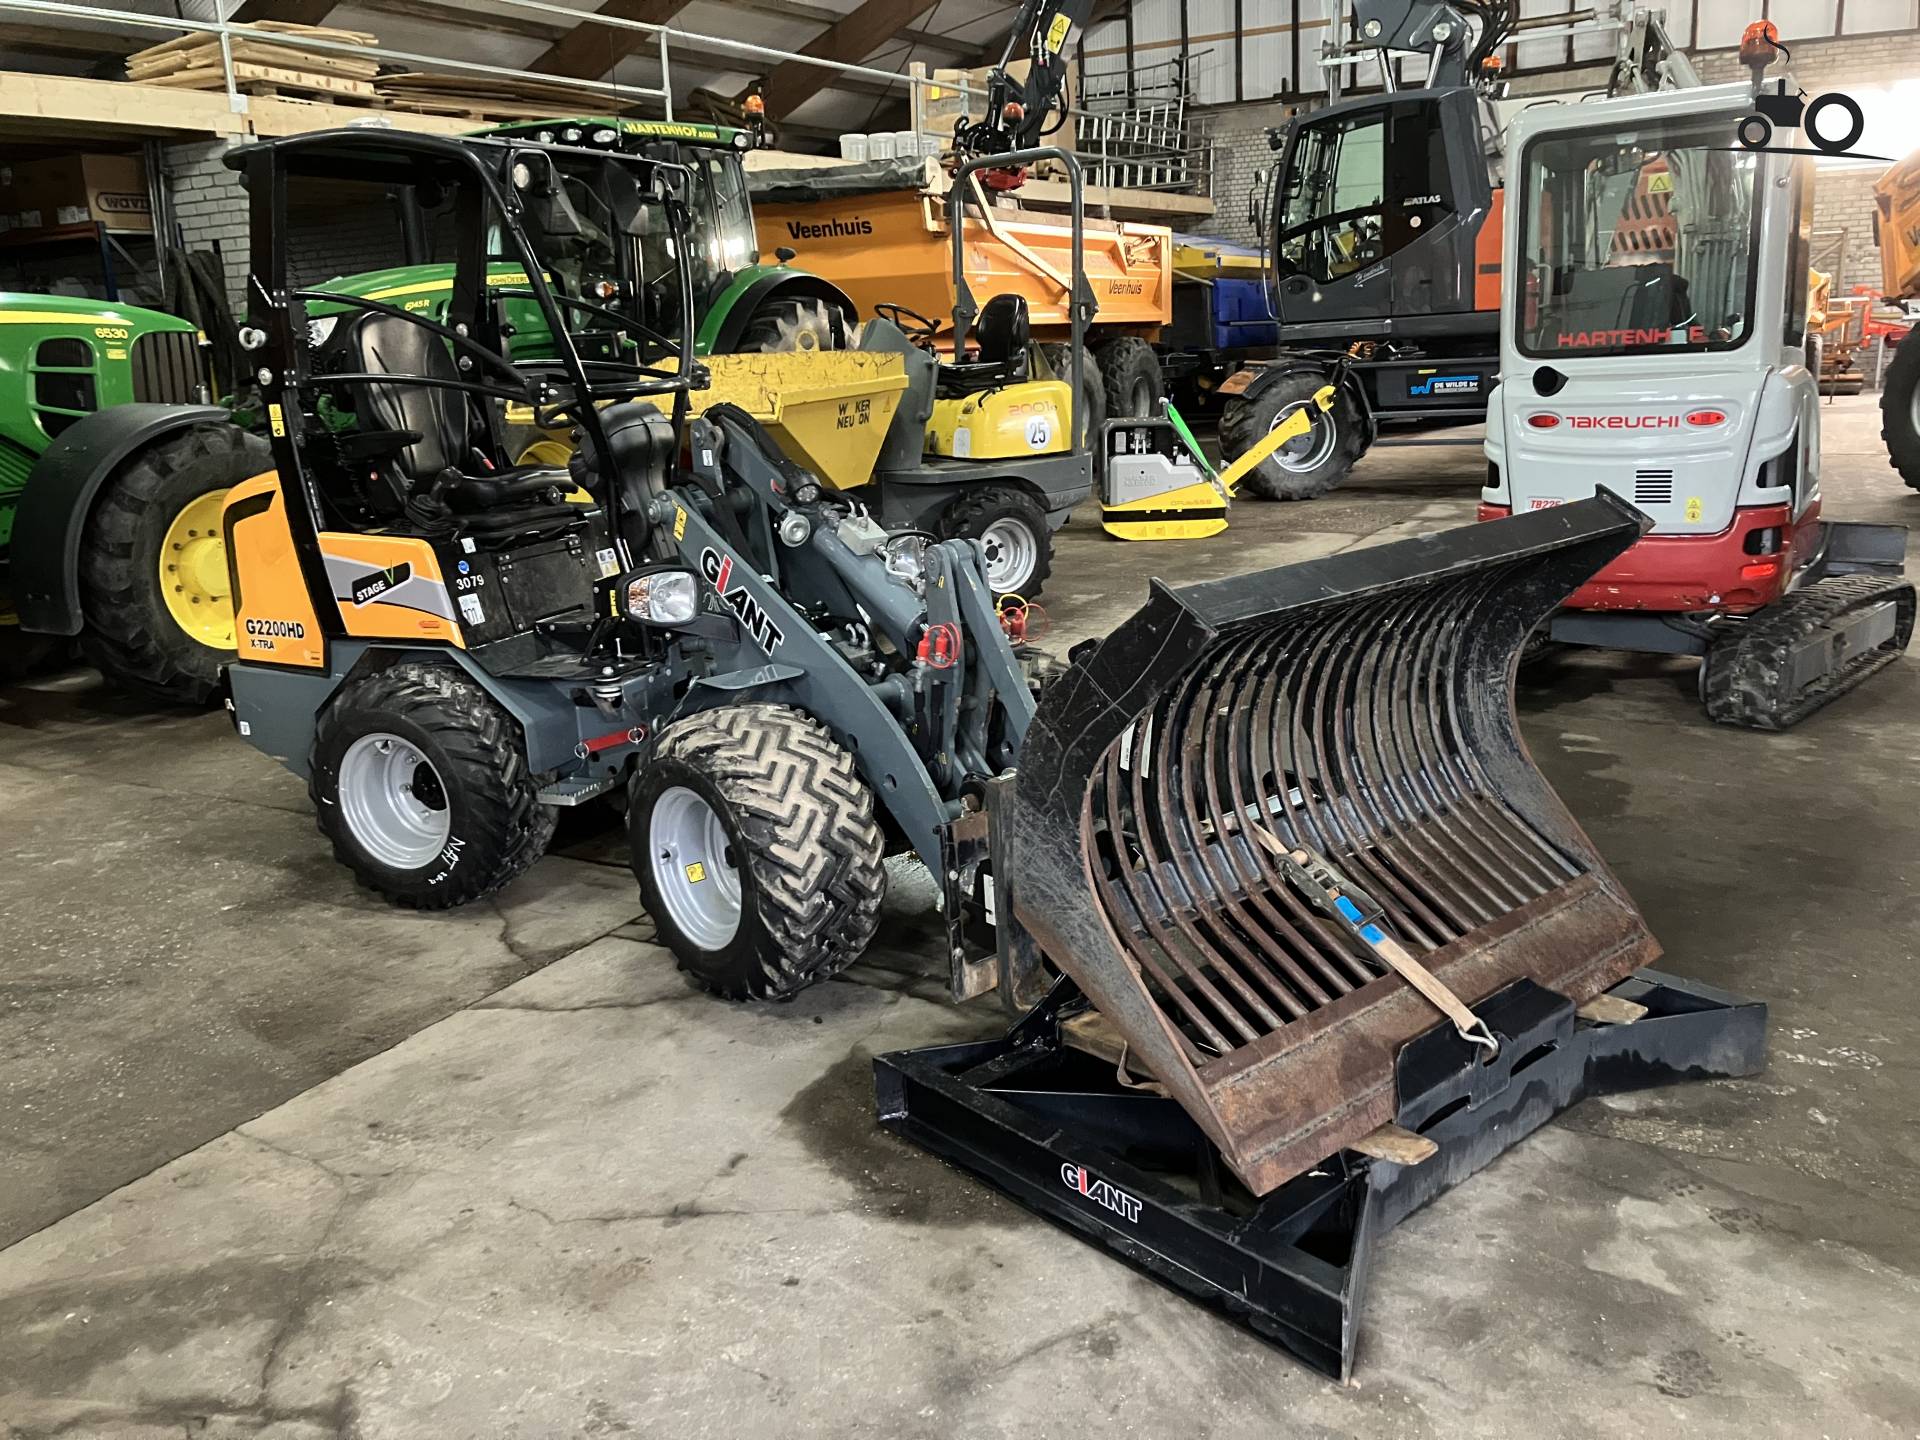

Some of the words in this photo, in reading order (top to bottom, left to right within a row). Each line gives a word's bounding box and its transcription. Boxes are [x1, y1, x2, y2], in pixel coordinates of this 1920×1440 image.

[625, 122, 698, 137] HARTENHOF
[1410, 194, 1441, 205] ATLAS
[786, 216, 873, 239] Veenhuis
[95, 327, 128, 340] 6530
[1565, 415, 1680, 429] TAKEUCHI
[1030, 422, 1046, 444] 25
[356, 580, 387, 601] STAGE
[456, 574, 485, 590] 3079
[700, 546, 785, 657] GIANT
[246, 619, 305, 639] G2200HD
[250, 639, 275, 649] X-TRA
[1060, 1163, 1143, 1224] GIANT
